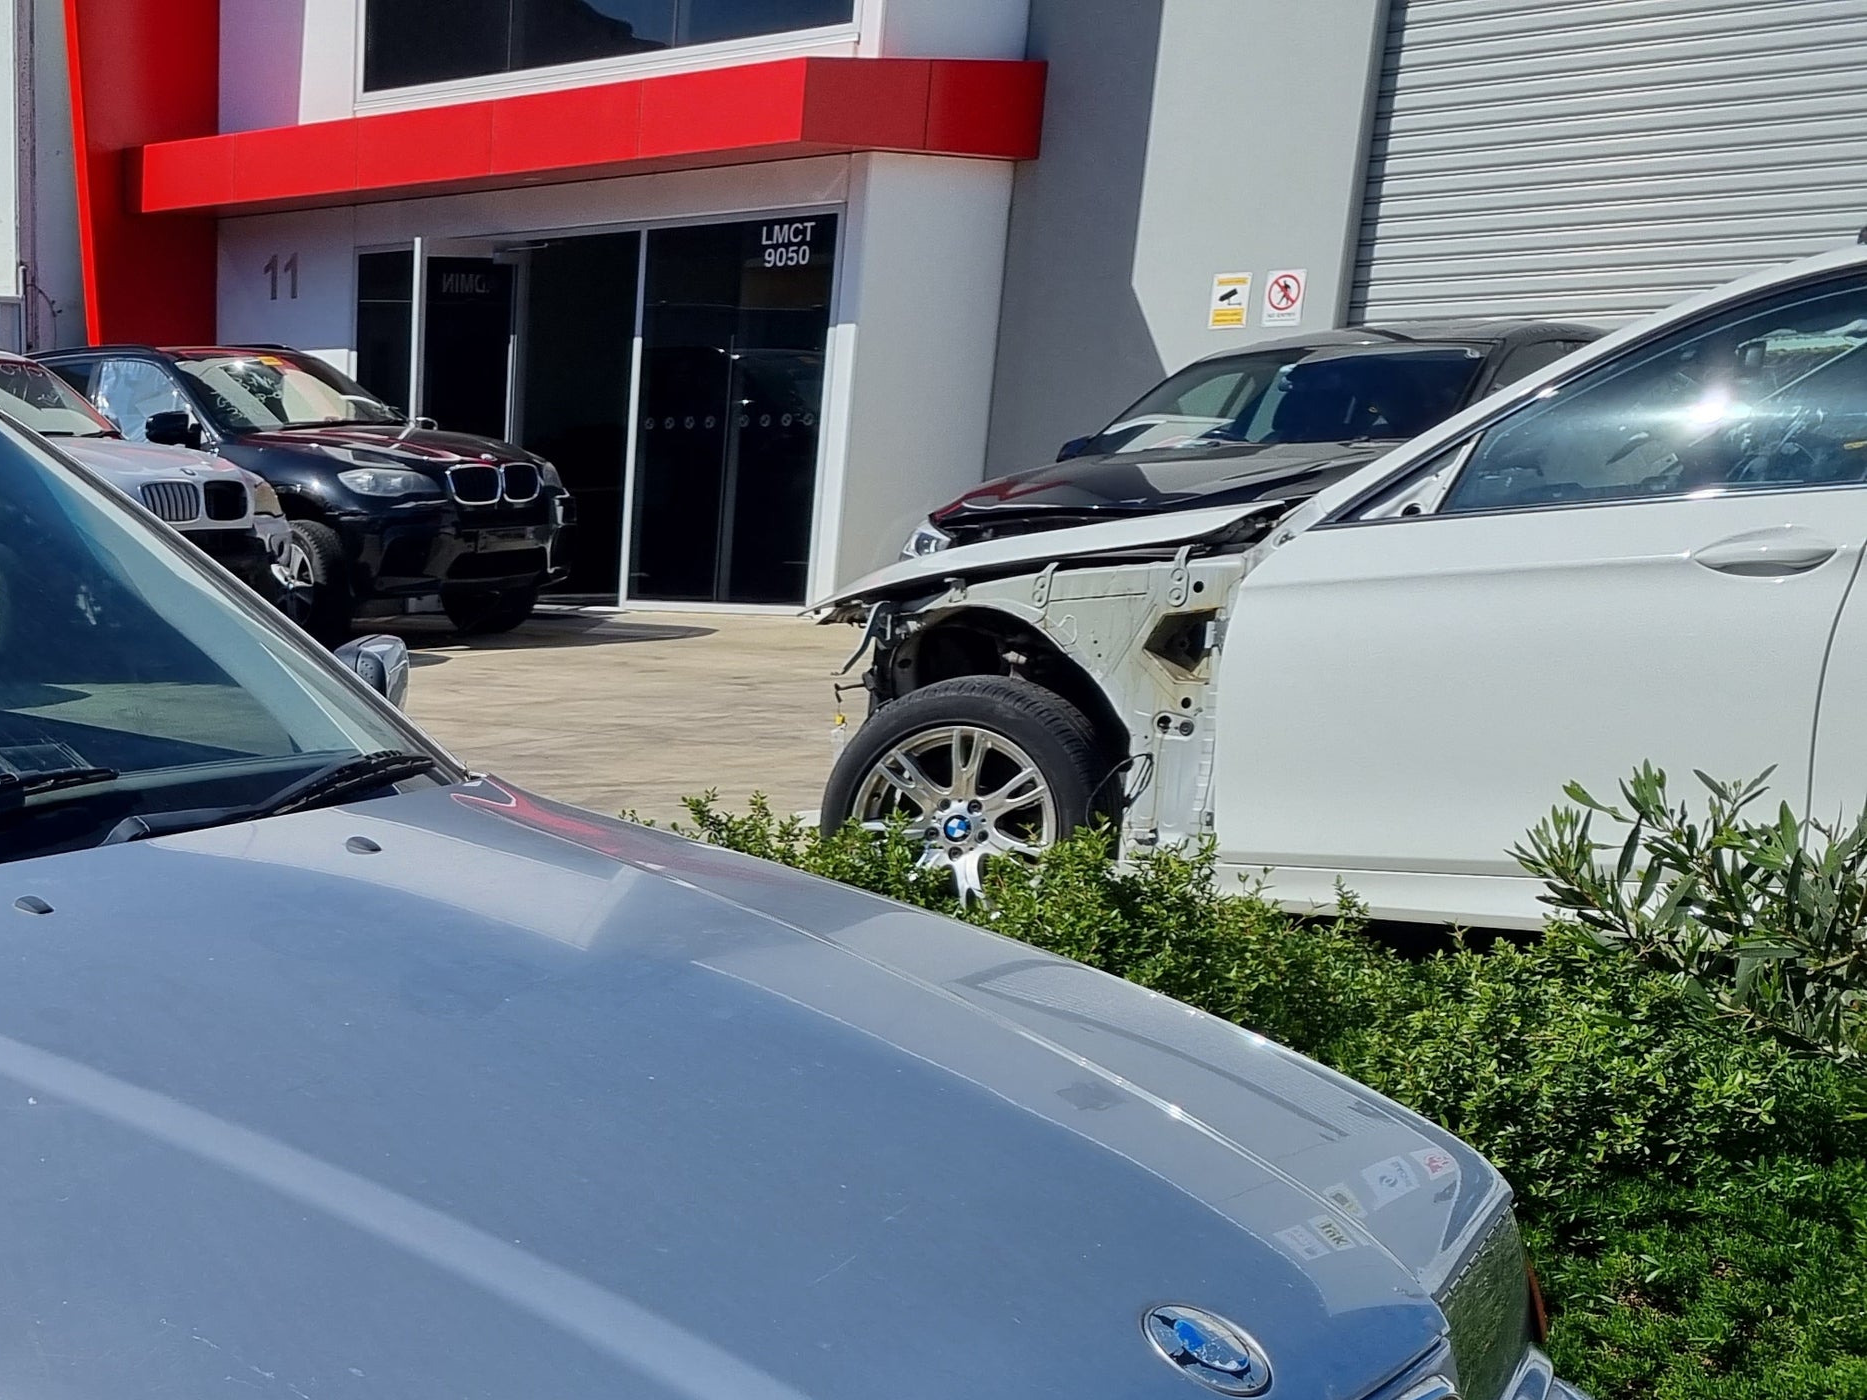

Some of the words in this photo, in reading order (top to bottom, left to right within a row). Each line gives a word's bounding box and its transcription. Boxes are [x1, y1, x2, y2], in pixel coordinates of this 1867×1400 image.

[761, 221, 816, 245] LMCT
[763, 245, 810, 268] 9050
[263, 252, 298, 300] 11
